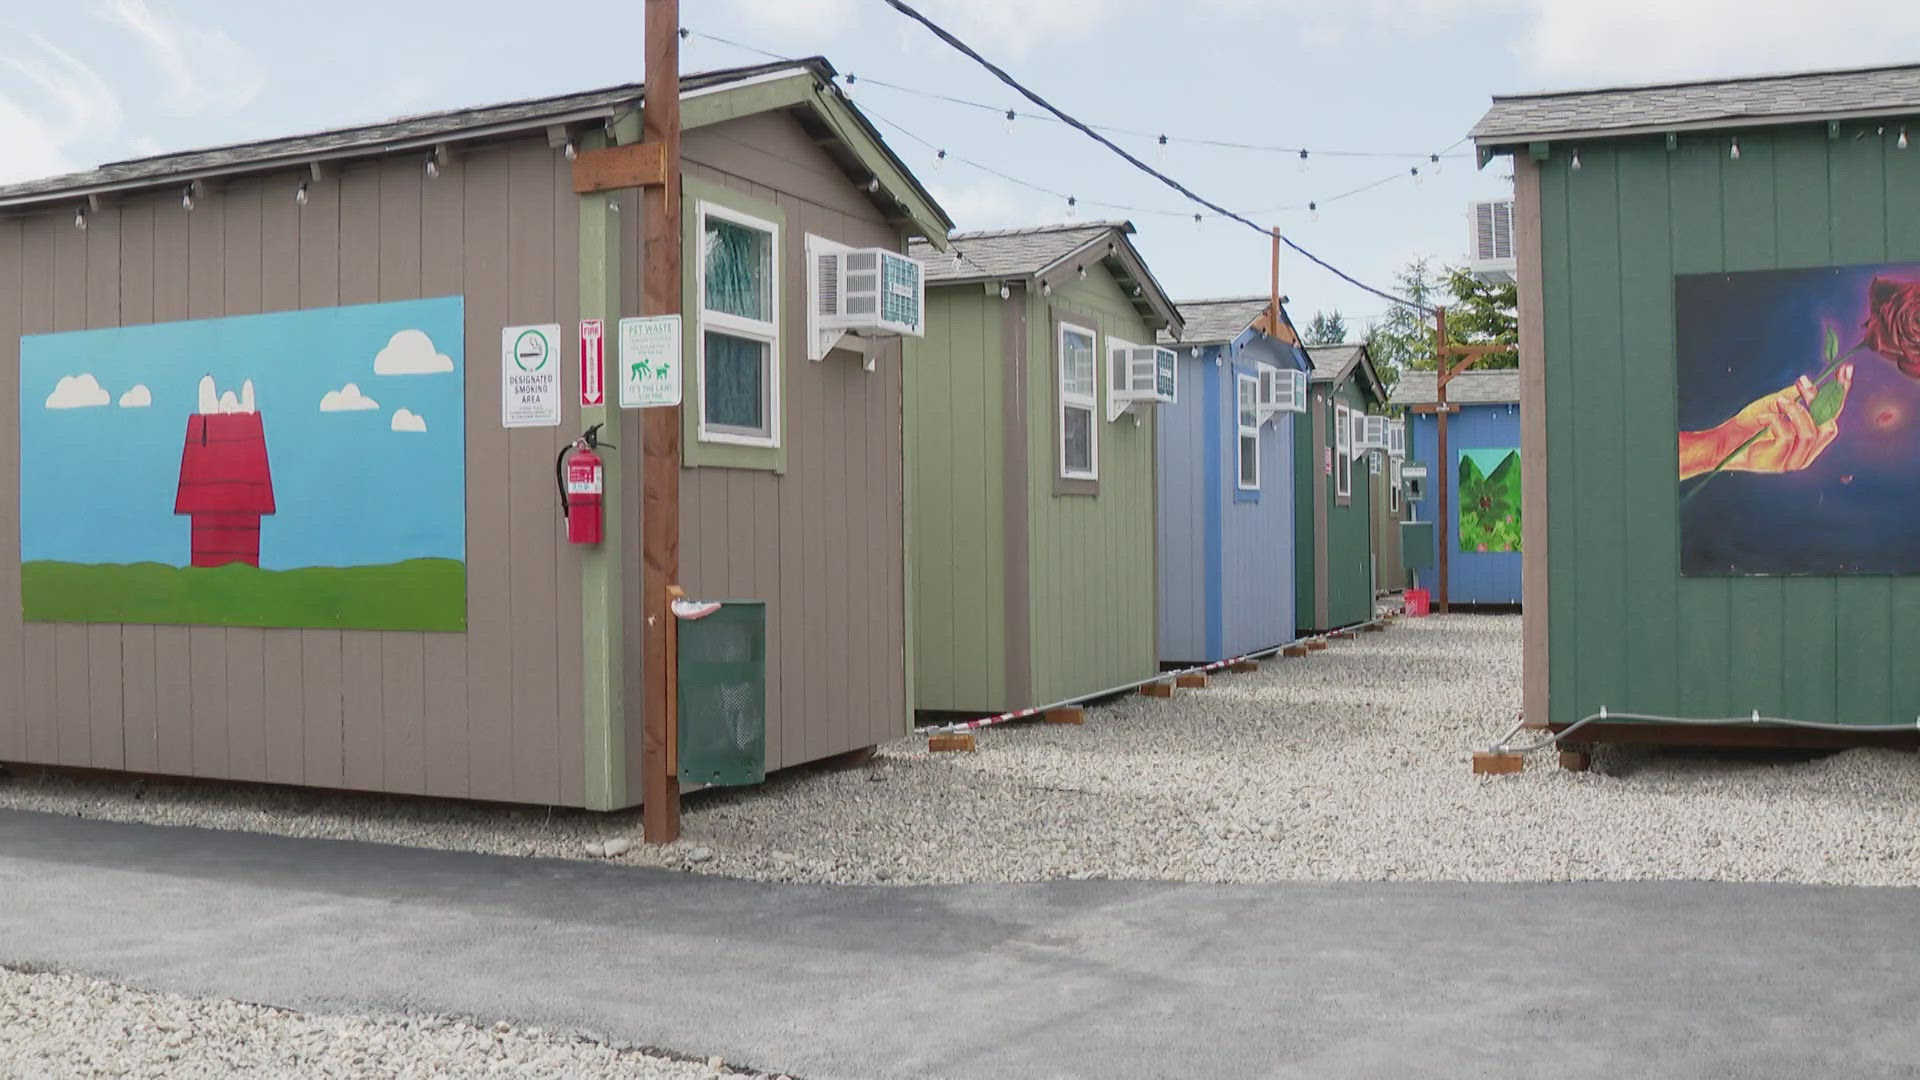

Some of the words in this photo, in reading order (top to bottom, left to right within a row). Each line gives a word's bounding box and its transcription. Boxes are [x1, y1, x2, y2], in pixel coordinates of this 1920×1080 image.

[584, 327, 599, 335] FIRE
[629, 325, 642, 334] PET
[645, 323, 672, 333] WASTE
[510, 375, 553, 384] DESIGNATED
[515, 385, 548, 394] SMOKING
[643, 384, 655, 393] THE
[522, 395, 541, 404] AREA
